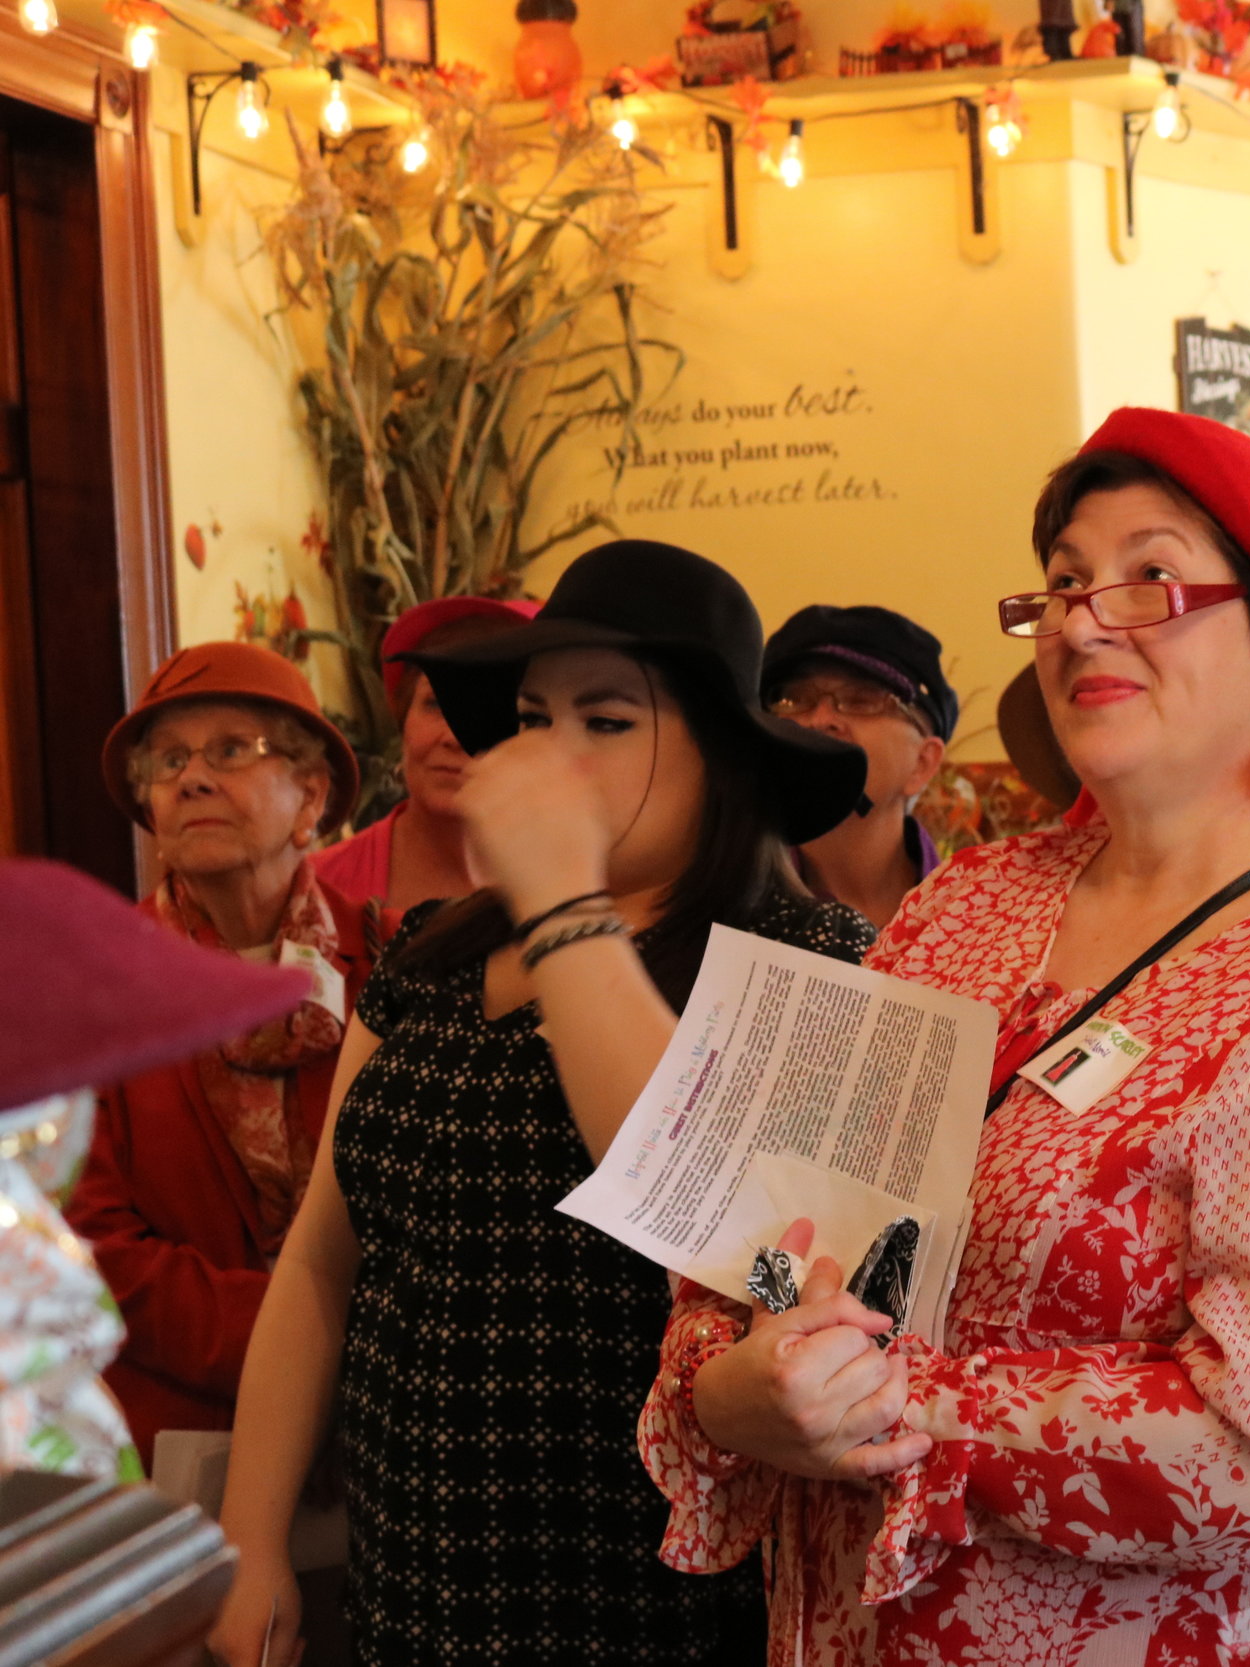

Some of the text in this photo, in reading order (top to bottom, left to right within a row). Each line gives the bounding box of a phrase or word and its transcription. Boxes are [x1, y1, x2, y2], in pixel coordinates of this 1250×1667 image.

[580, 384, 873, 434] Aays do your best.
[674, 448, 713, 474] you
[720, 438, 779, 470] plant
[785, 441, 839, 459] now,
[688, 475, 804, 509] harvest
[814, 468, 897, 502] later.
